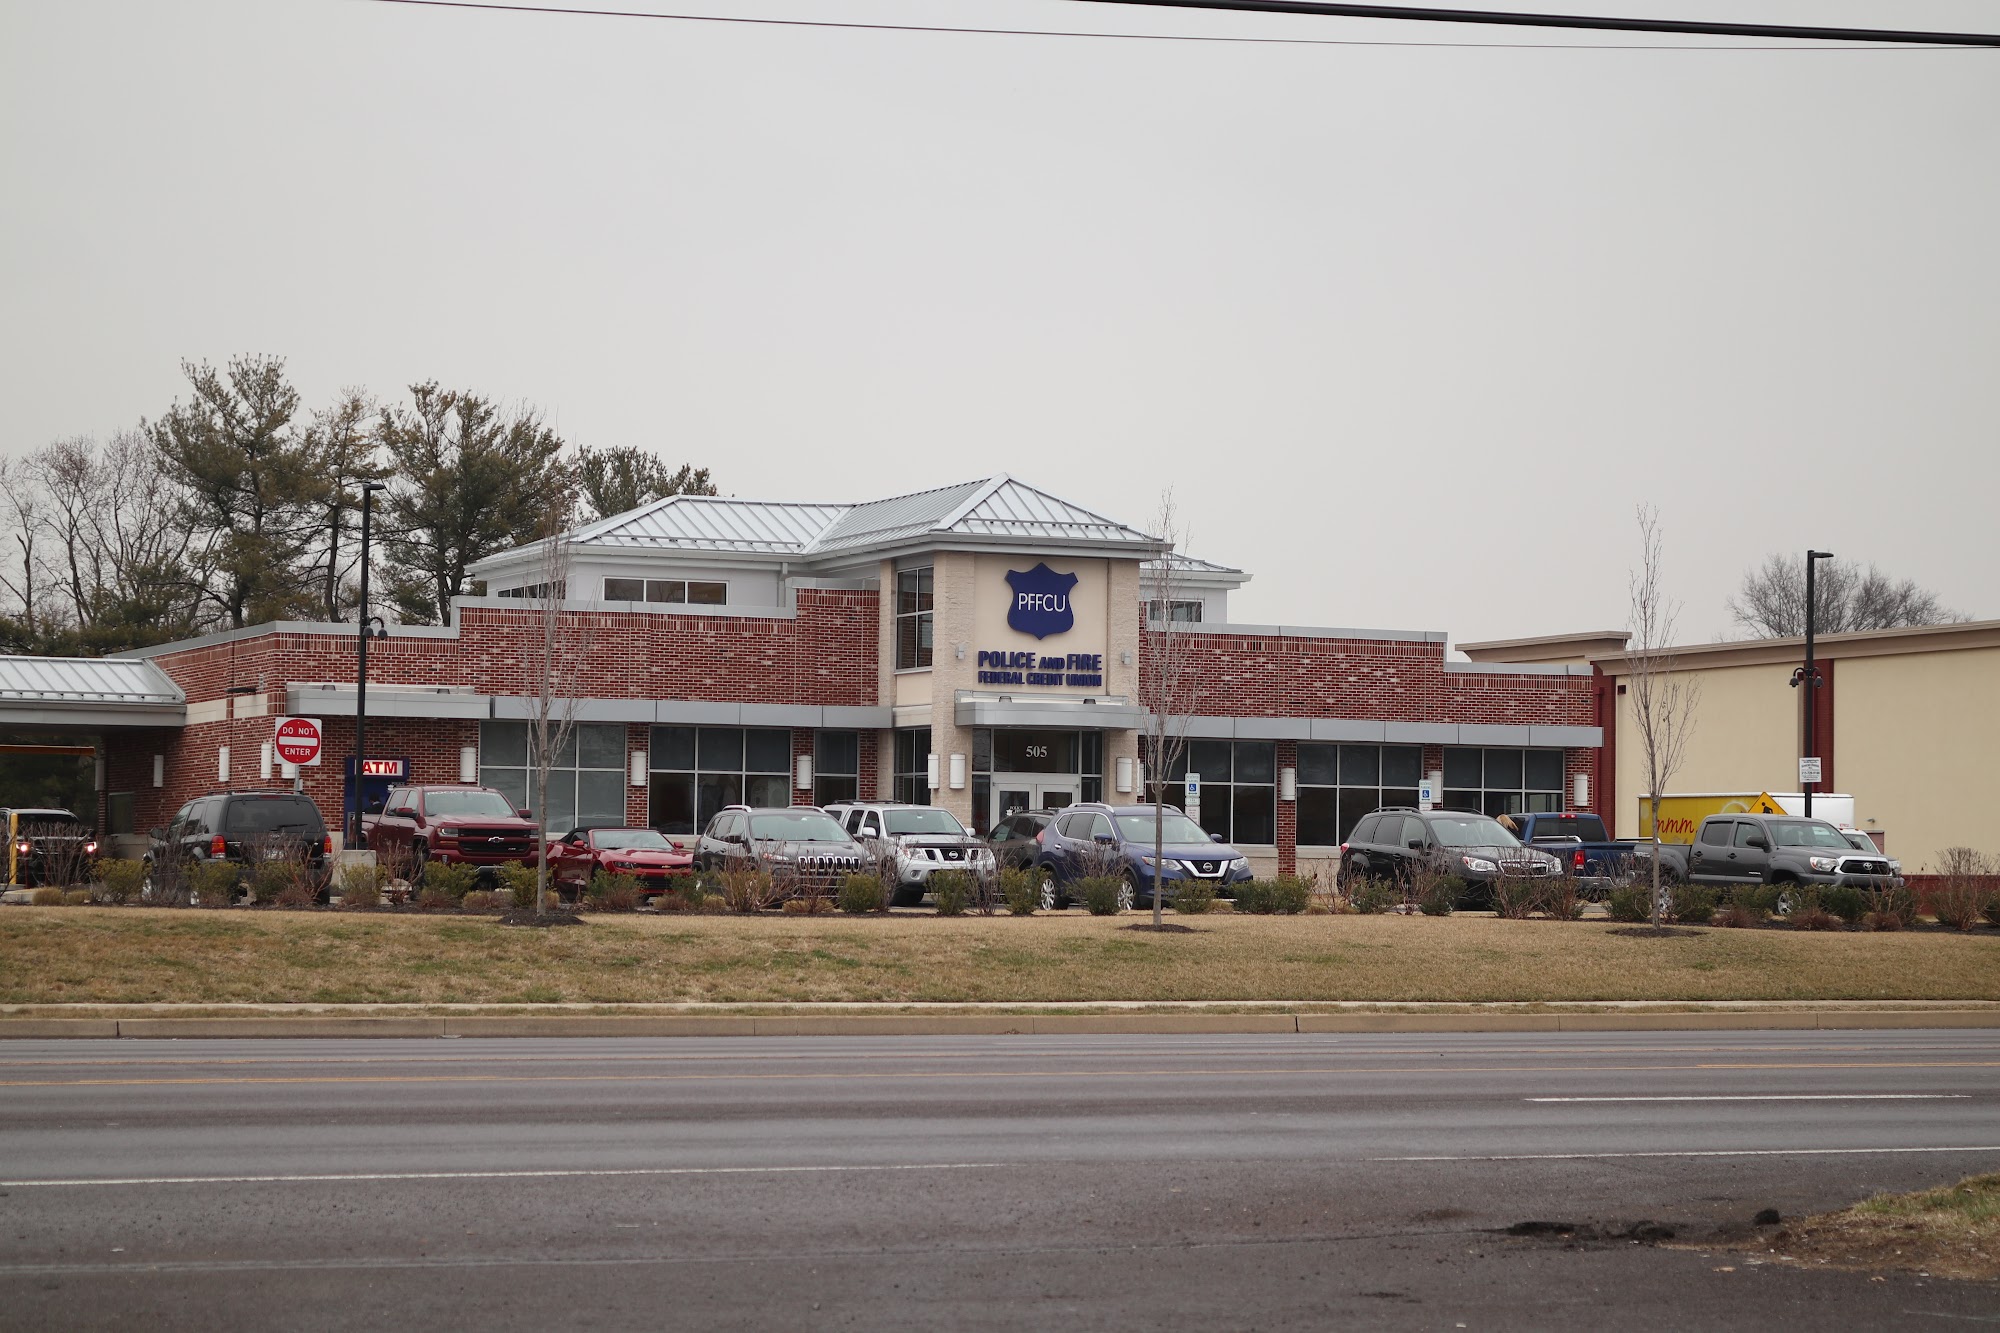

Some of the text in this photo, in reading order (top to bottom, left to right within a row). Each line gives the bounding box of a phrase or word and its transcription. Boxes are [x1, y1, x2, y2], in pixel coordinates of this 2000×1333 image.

[1018, 592, 1066, 612] PFFCU
[978, 650, 1102, 671] POLICE AND FIRE
[978, 670, 1102, 687] FEDERAL CREDIT UNION
[282, 726, 314, 736] DO NOT
[284, 747, 311, 756] ENTER
[1025, 745, 1048, 758] 505
[362, 761, 398, 774] ATM
